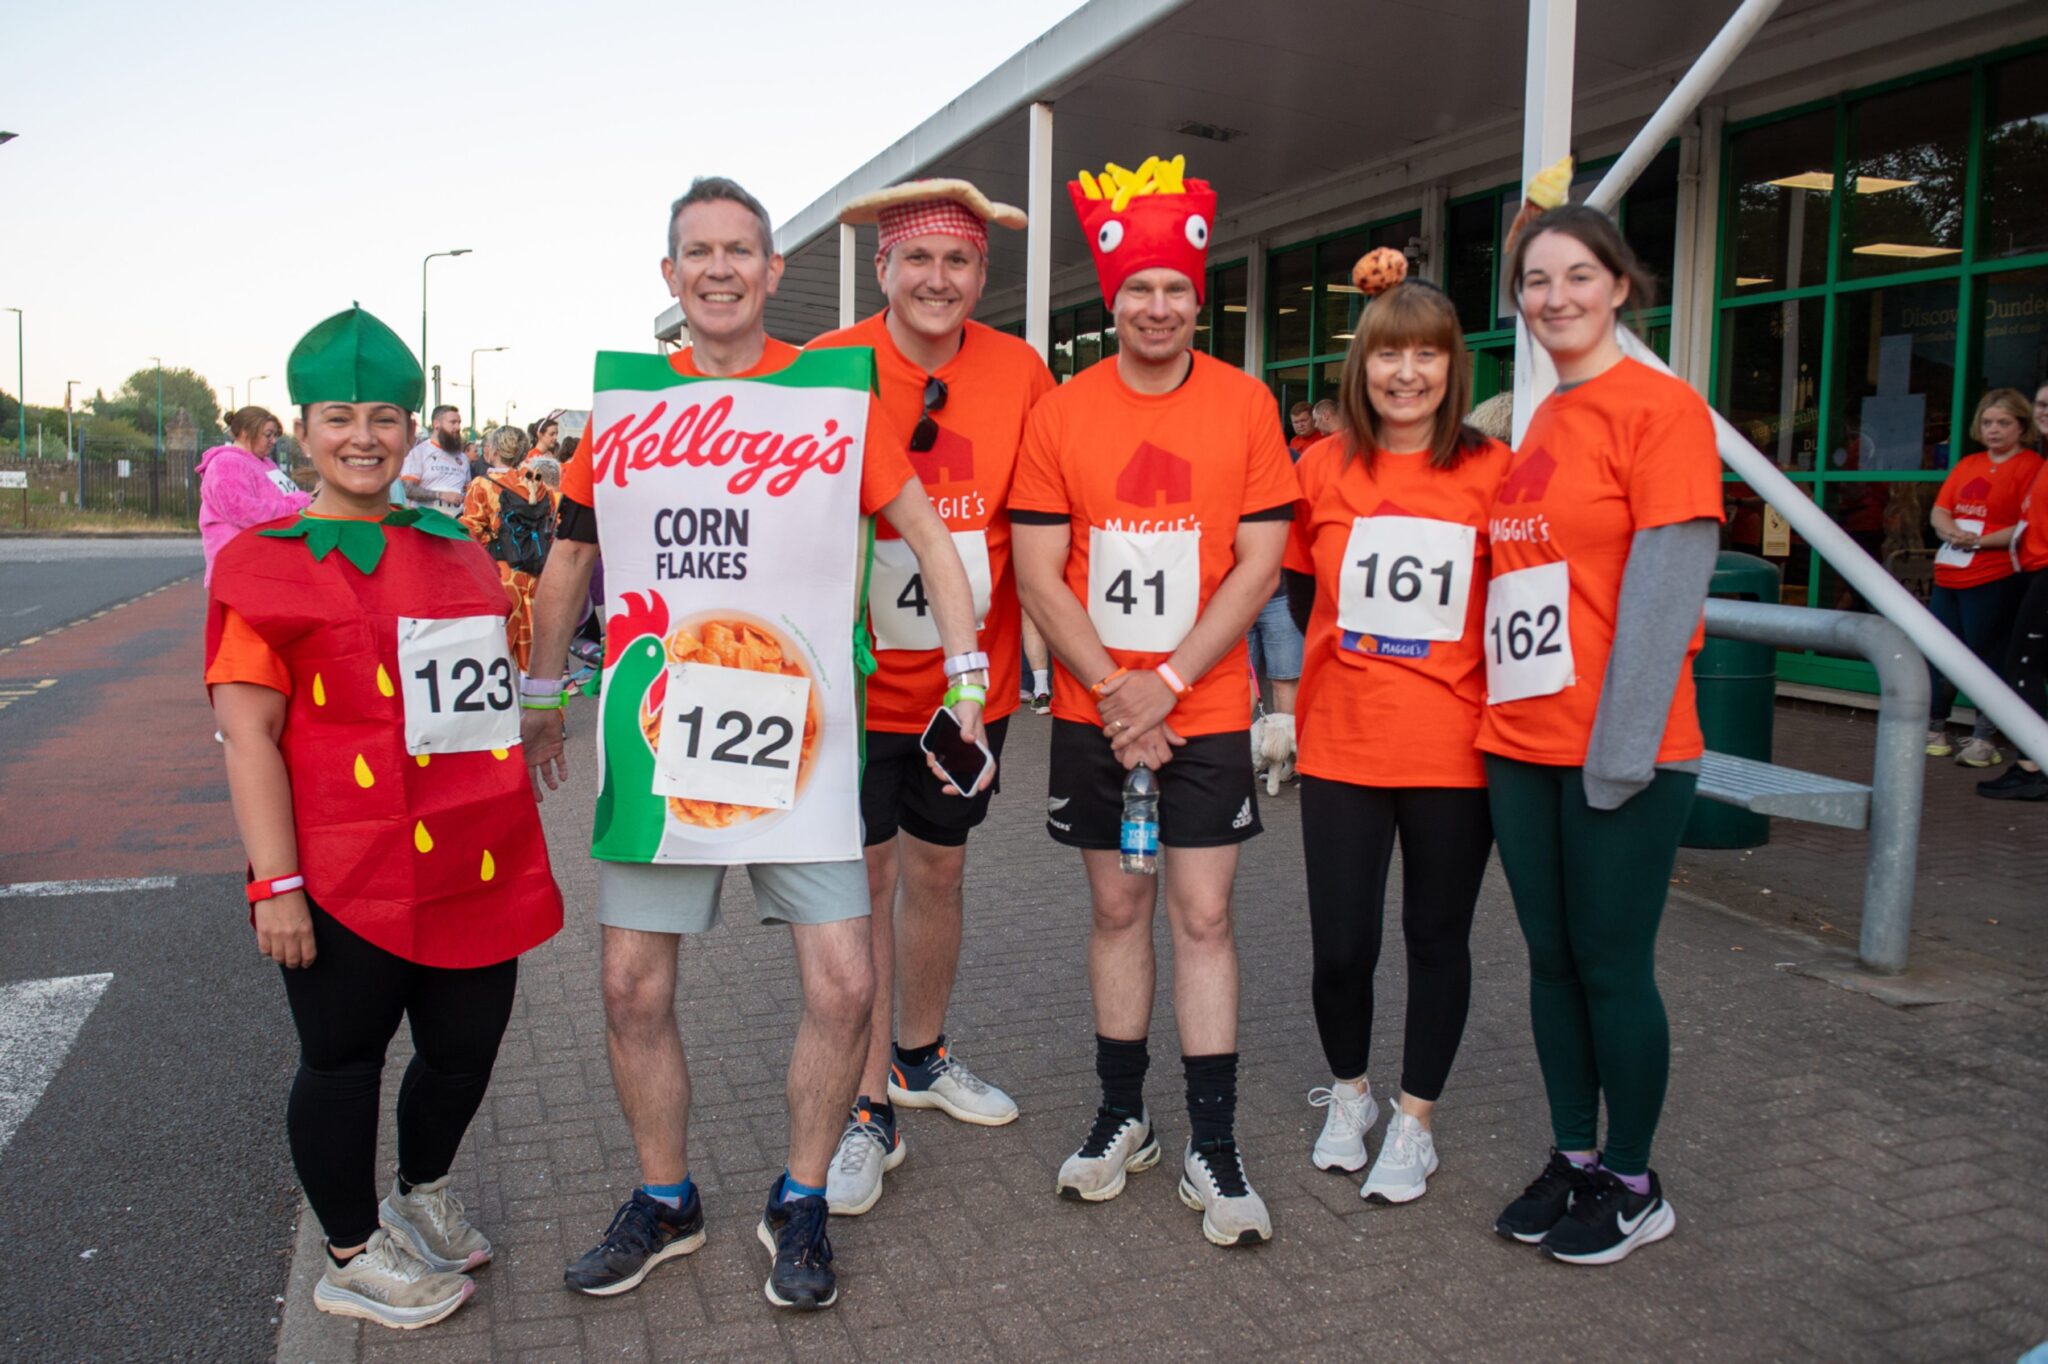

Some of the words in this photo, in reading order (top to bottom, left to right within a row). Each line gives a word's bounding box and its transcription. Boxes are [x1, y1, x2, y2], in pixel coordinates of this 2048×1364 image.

[593, 395, 853, 497] Kellogg's
[654, 507, 749, 547] CORN
[928, 490, 985, 519] GIE'S
[656, 552, 747, 580] FLAKES
[1105, 569, 1165, 615] 41
[1357, 552, 1454, 606] 161
[1491, 605, 1562, 664] 162
[414, 657, 514, 713] 123
[679, 705, 794, 769] 122
